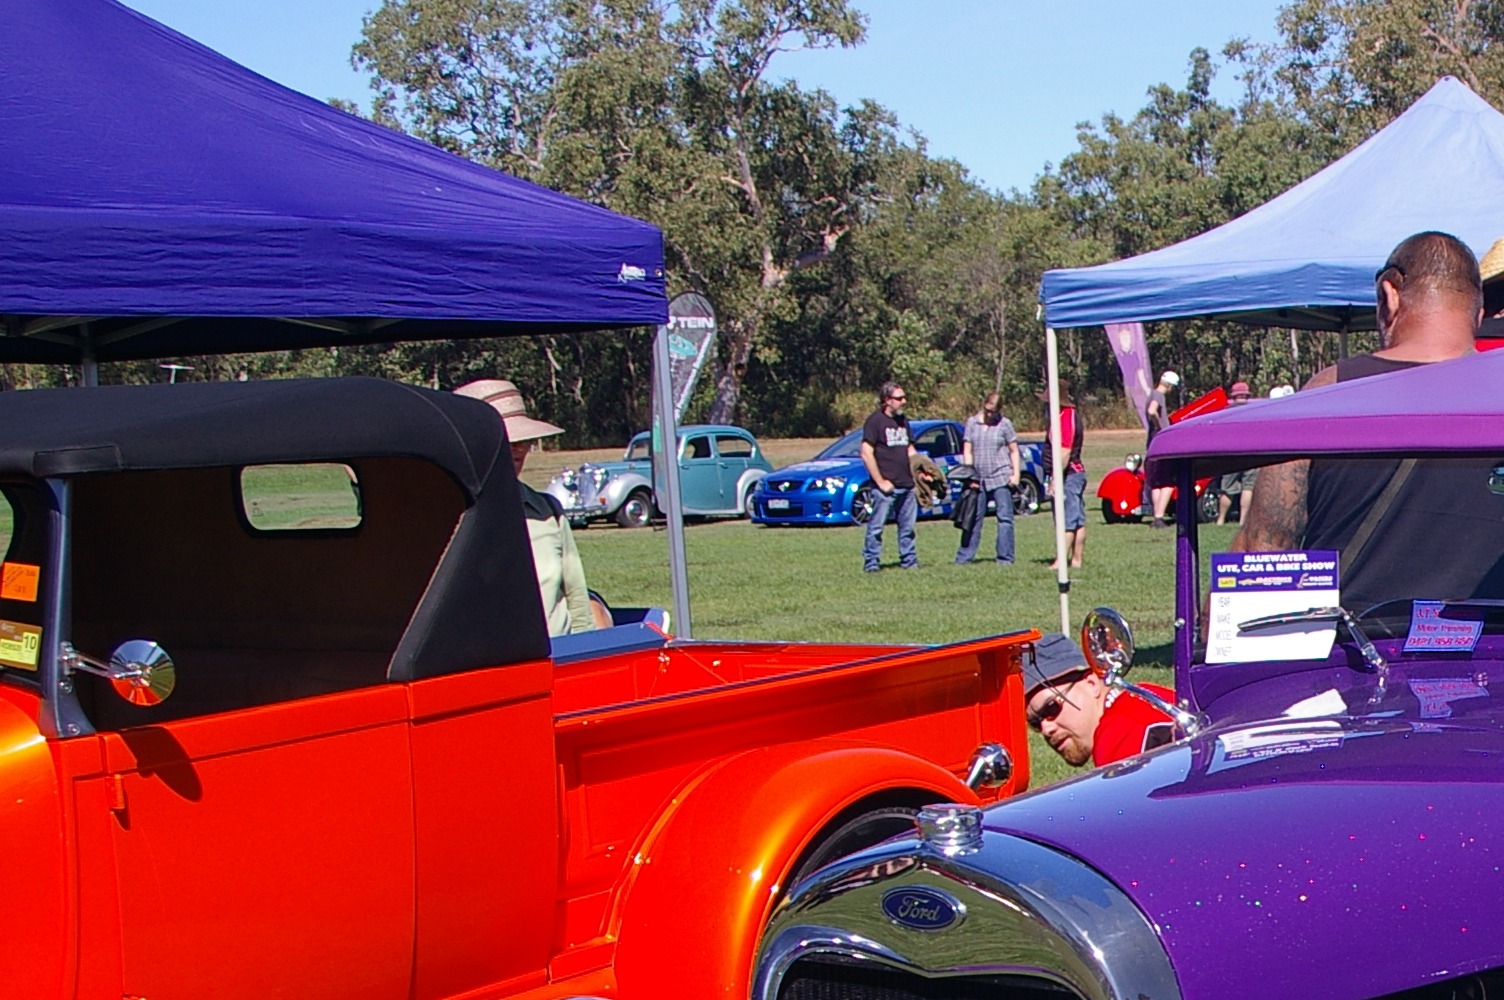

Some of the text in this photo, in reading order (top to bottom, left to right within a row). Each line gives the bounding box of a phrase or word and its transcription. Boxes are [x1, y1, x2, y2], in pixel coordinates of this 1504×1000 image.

[678, 316, 714, 329] TEIN
[1243, 553, 1308, 563] BLUEWATER
[1217, 561, 1335, 573] UTE, CAR & BIKE SHOW
[24, 635, 37, 650] 10
[898, 895, 941, 921] Ford
